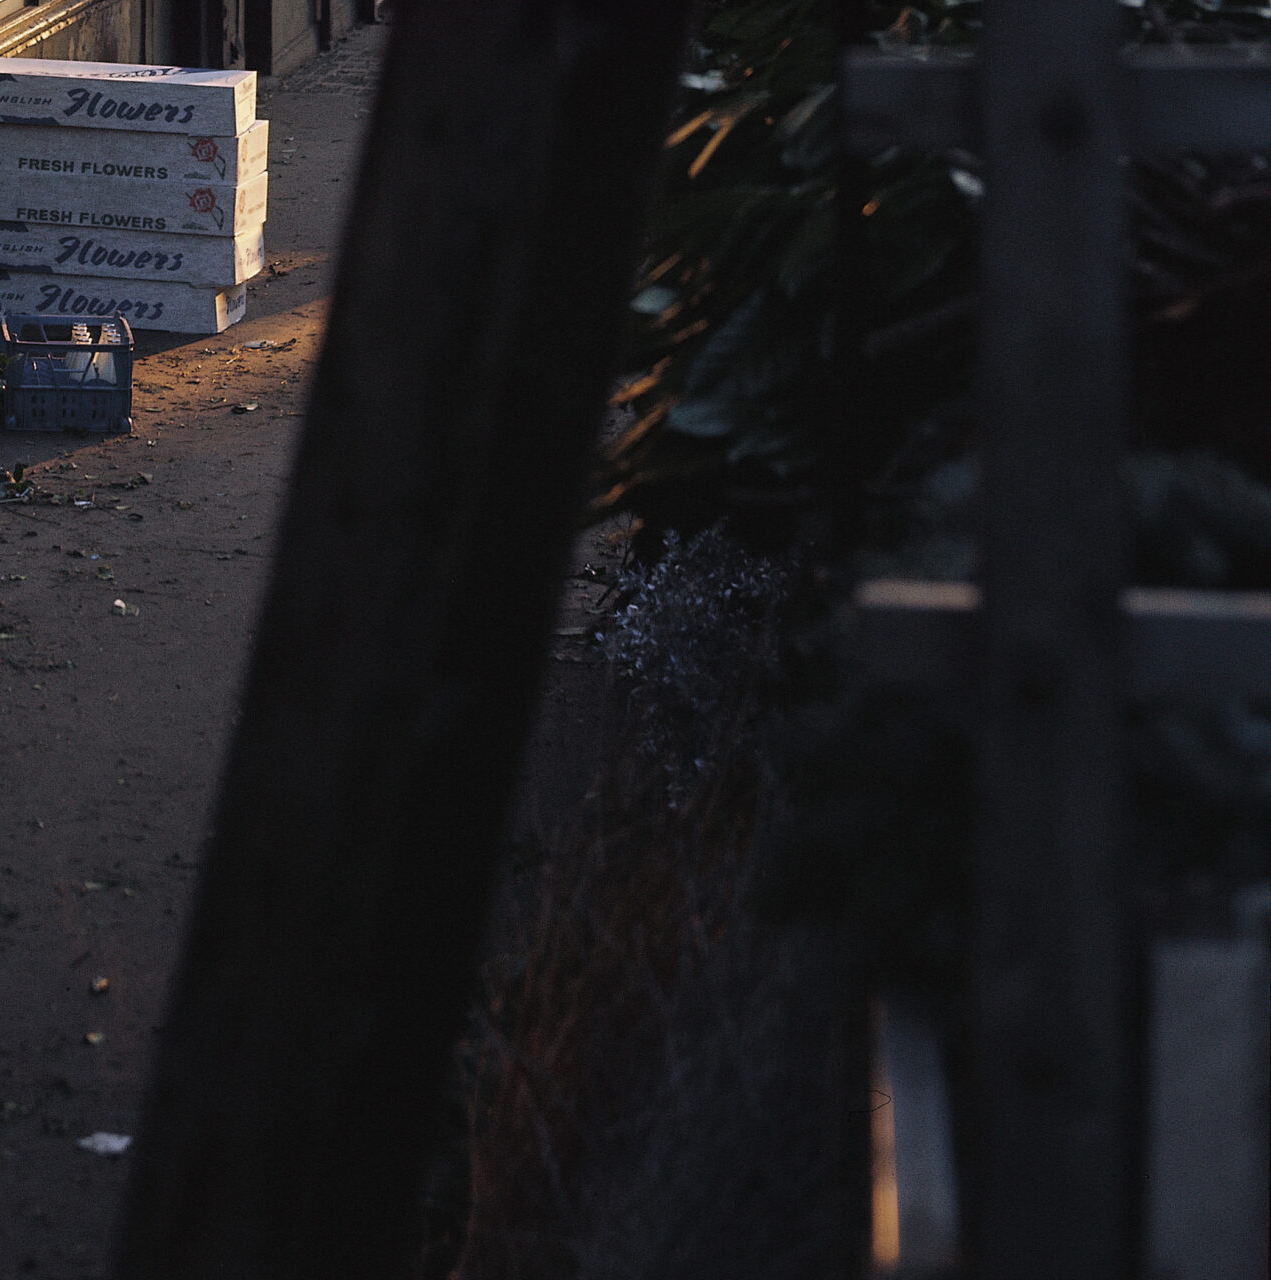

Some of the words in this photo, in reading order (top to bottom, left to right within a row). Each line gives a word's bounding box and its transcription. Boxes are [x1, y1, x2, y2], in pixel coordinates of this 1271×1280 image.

[63, 88, 196, 124] Flowers
[18, 158, 74, 174] FRESH
[82, 162, 169, 180] FLOWERS
[16, 207, 72, 224] FRESH
[79, 211, 167, 230] FLOWERS
[55, 236, 185, 272] Flowers
[36, 285, 165, 320] Flowers
